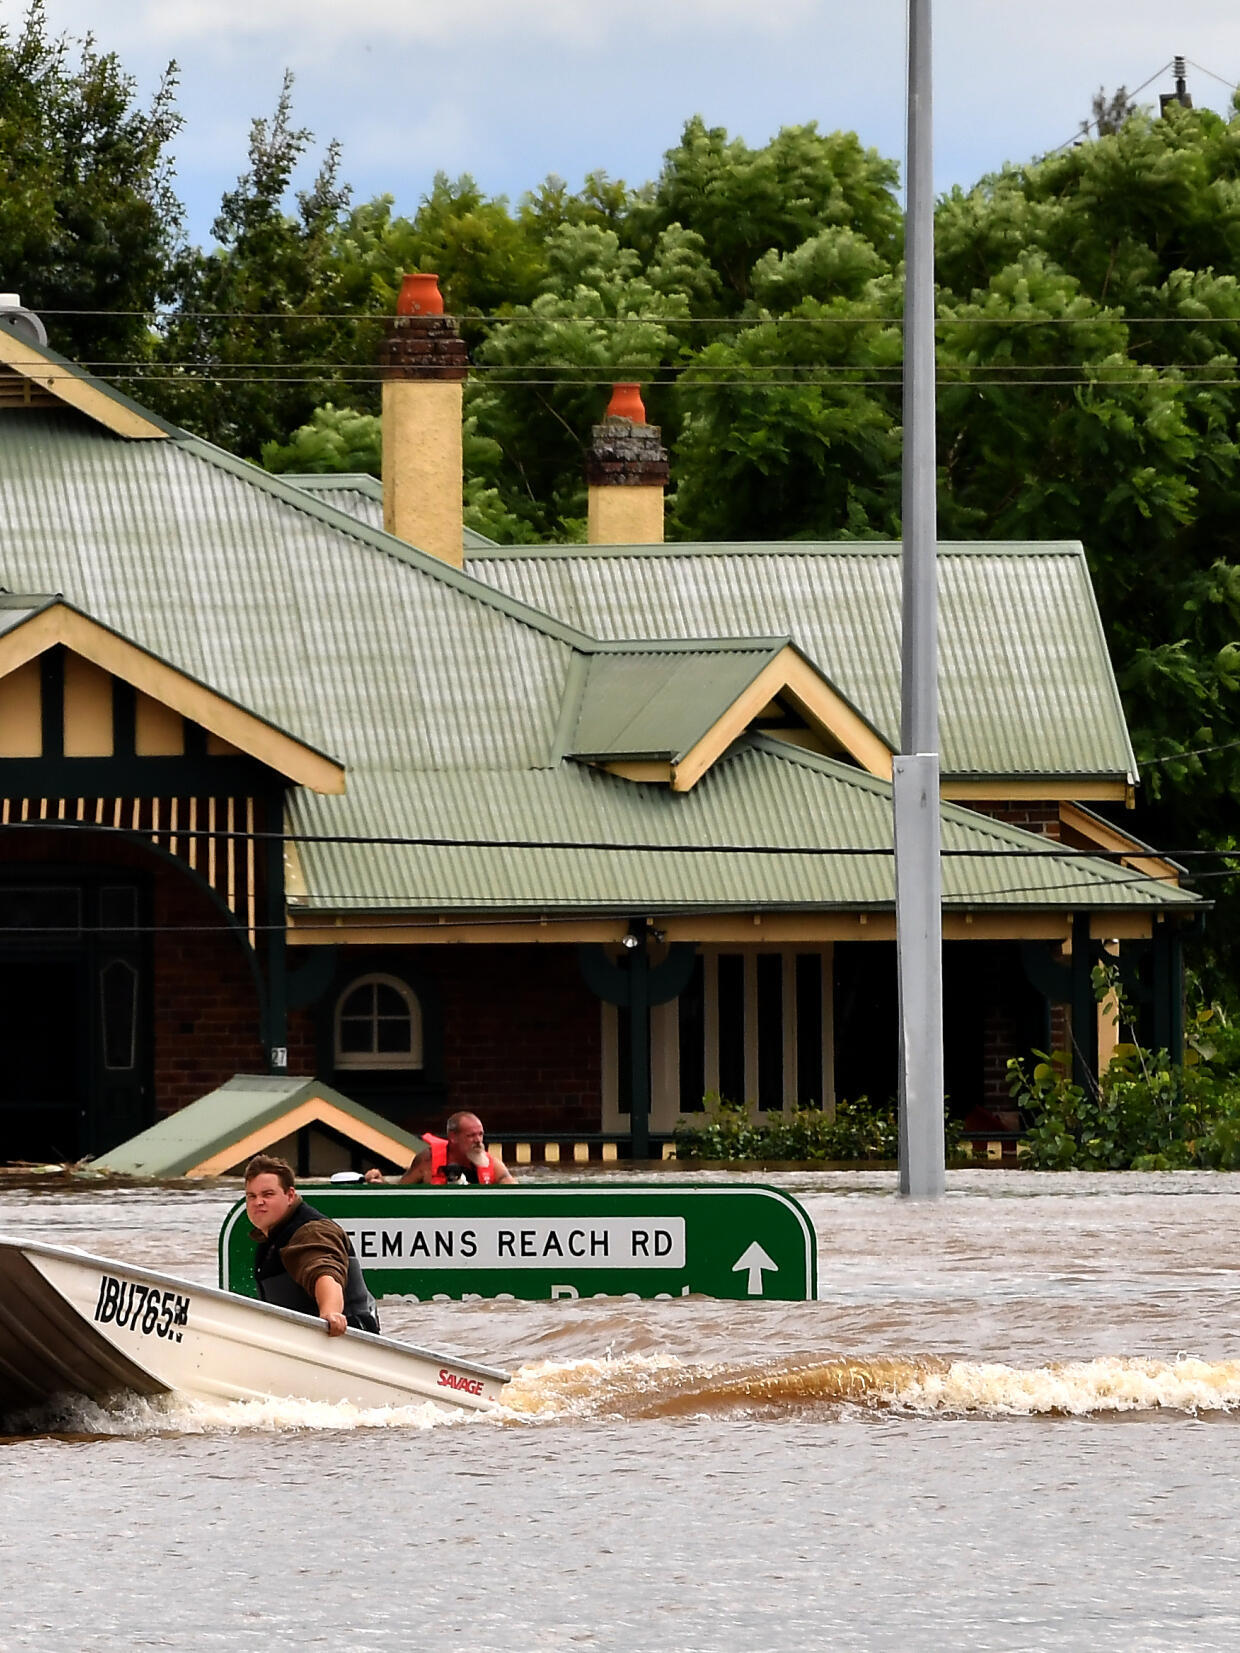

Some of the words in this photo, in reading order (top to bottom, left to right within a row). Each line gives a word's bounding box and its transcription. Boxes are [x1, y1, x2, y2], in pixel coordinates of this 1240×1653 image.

[272, 1049, 286, 1065] 27
[498, 1230, 609, 1257] REACH
[631, 1230, 673, 1257] RD
[437, 1369, 485, 1396] SAVAGE
